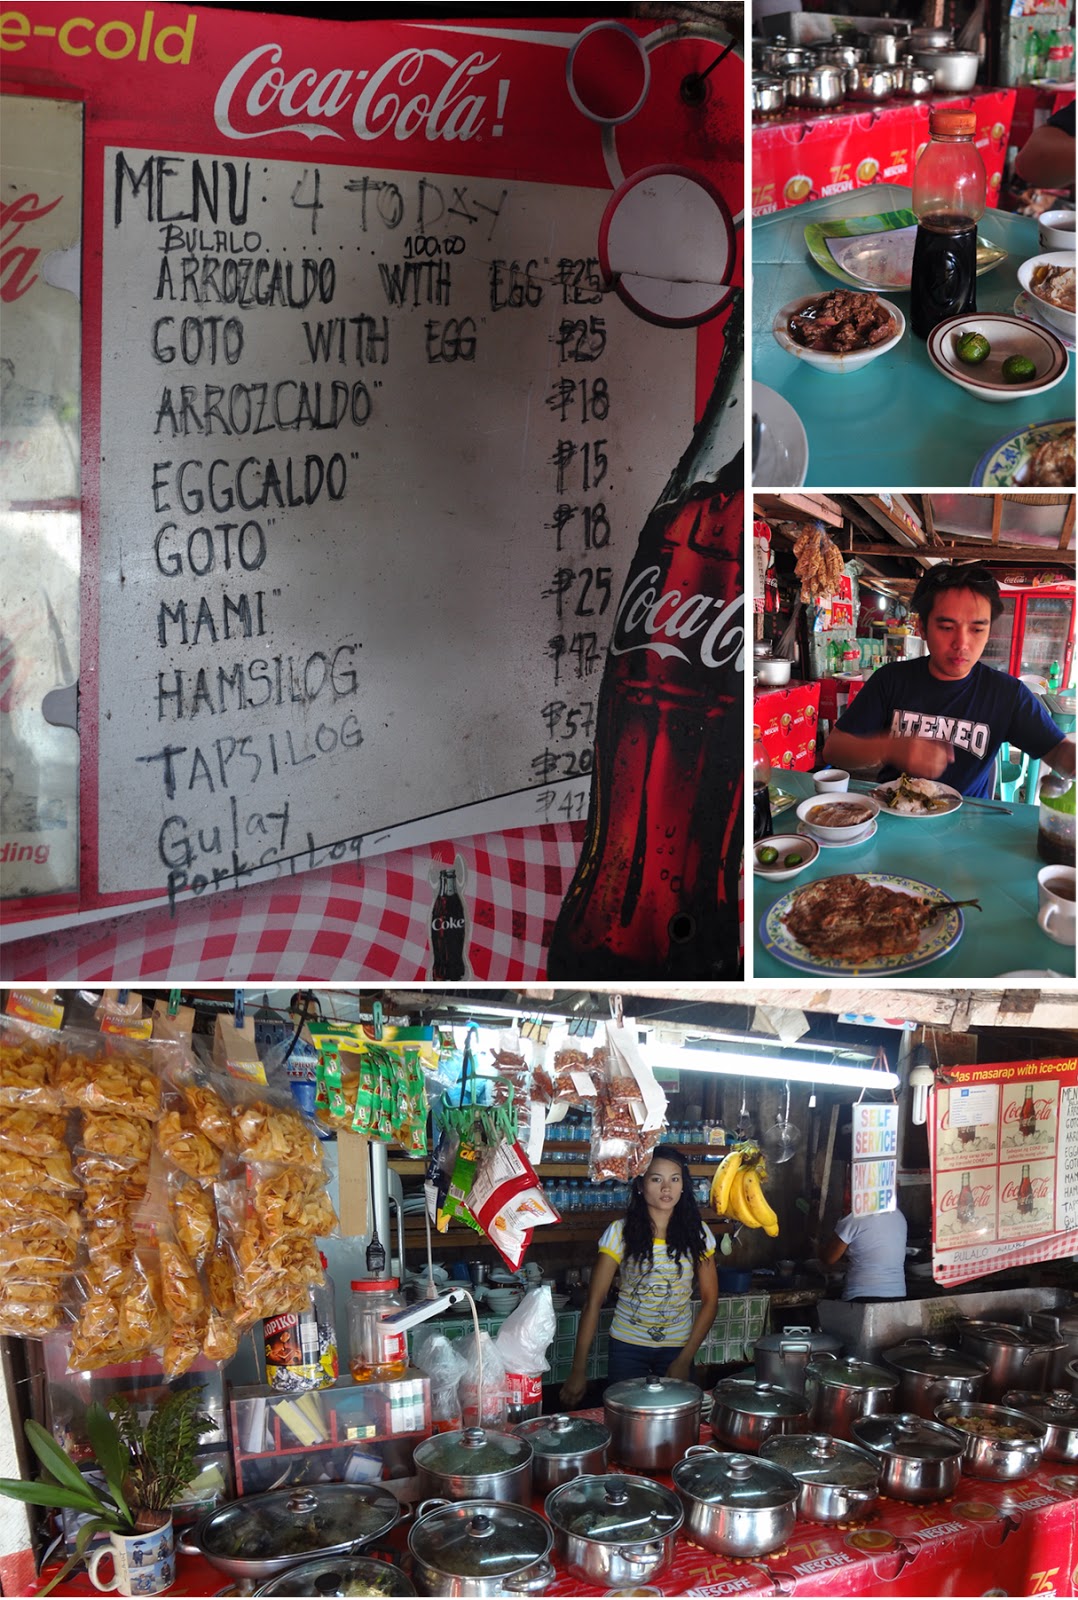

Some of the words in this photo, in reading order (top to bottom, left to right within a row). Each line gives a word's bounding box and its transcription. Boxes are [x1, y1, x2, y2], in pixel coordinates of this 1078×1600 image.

[290, 168, 324, 235] 4
[404, 235, 467, 260] 100.00
[153, 255, 337, 311] ARROZCALDO
[378, 260, 451, 307] WITH
[151, 315, 244, 366] GOTO
[302, 312, 389, 368] WITH
[890, 709, 991, 760] ATENEO
[135, 712, 365, 802] TAPSILOG
[157, 795, 290, 870] Gulay
[431, 916, 466, 931] Coke
[972, 1067, 1015, 1081] masarap
[1017, 1063, 1038, 1076] with
[1039, 1060, 1078, 1074] ice-cold
[861, 1109, 891, 1128] SELF
[855, 1130, 896, 1154] SERVICE
[855, 1189, 893, 1215] ORDER
[953, 1247, 989, 1263] BULALO
[1030, 1567, 1060, 1595] 75
